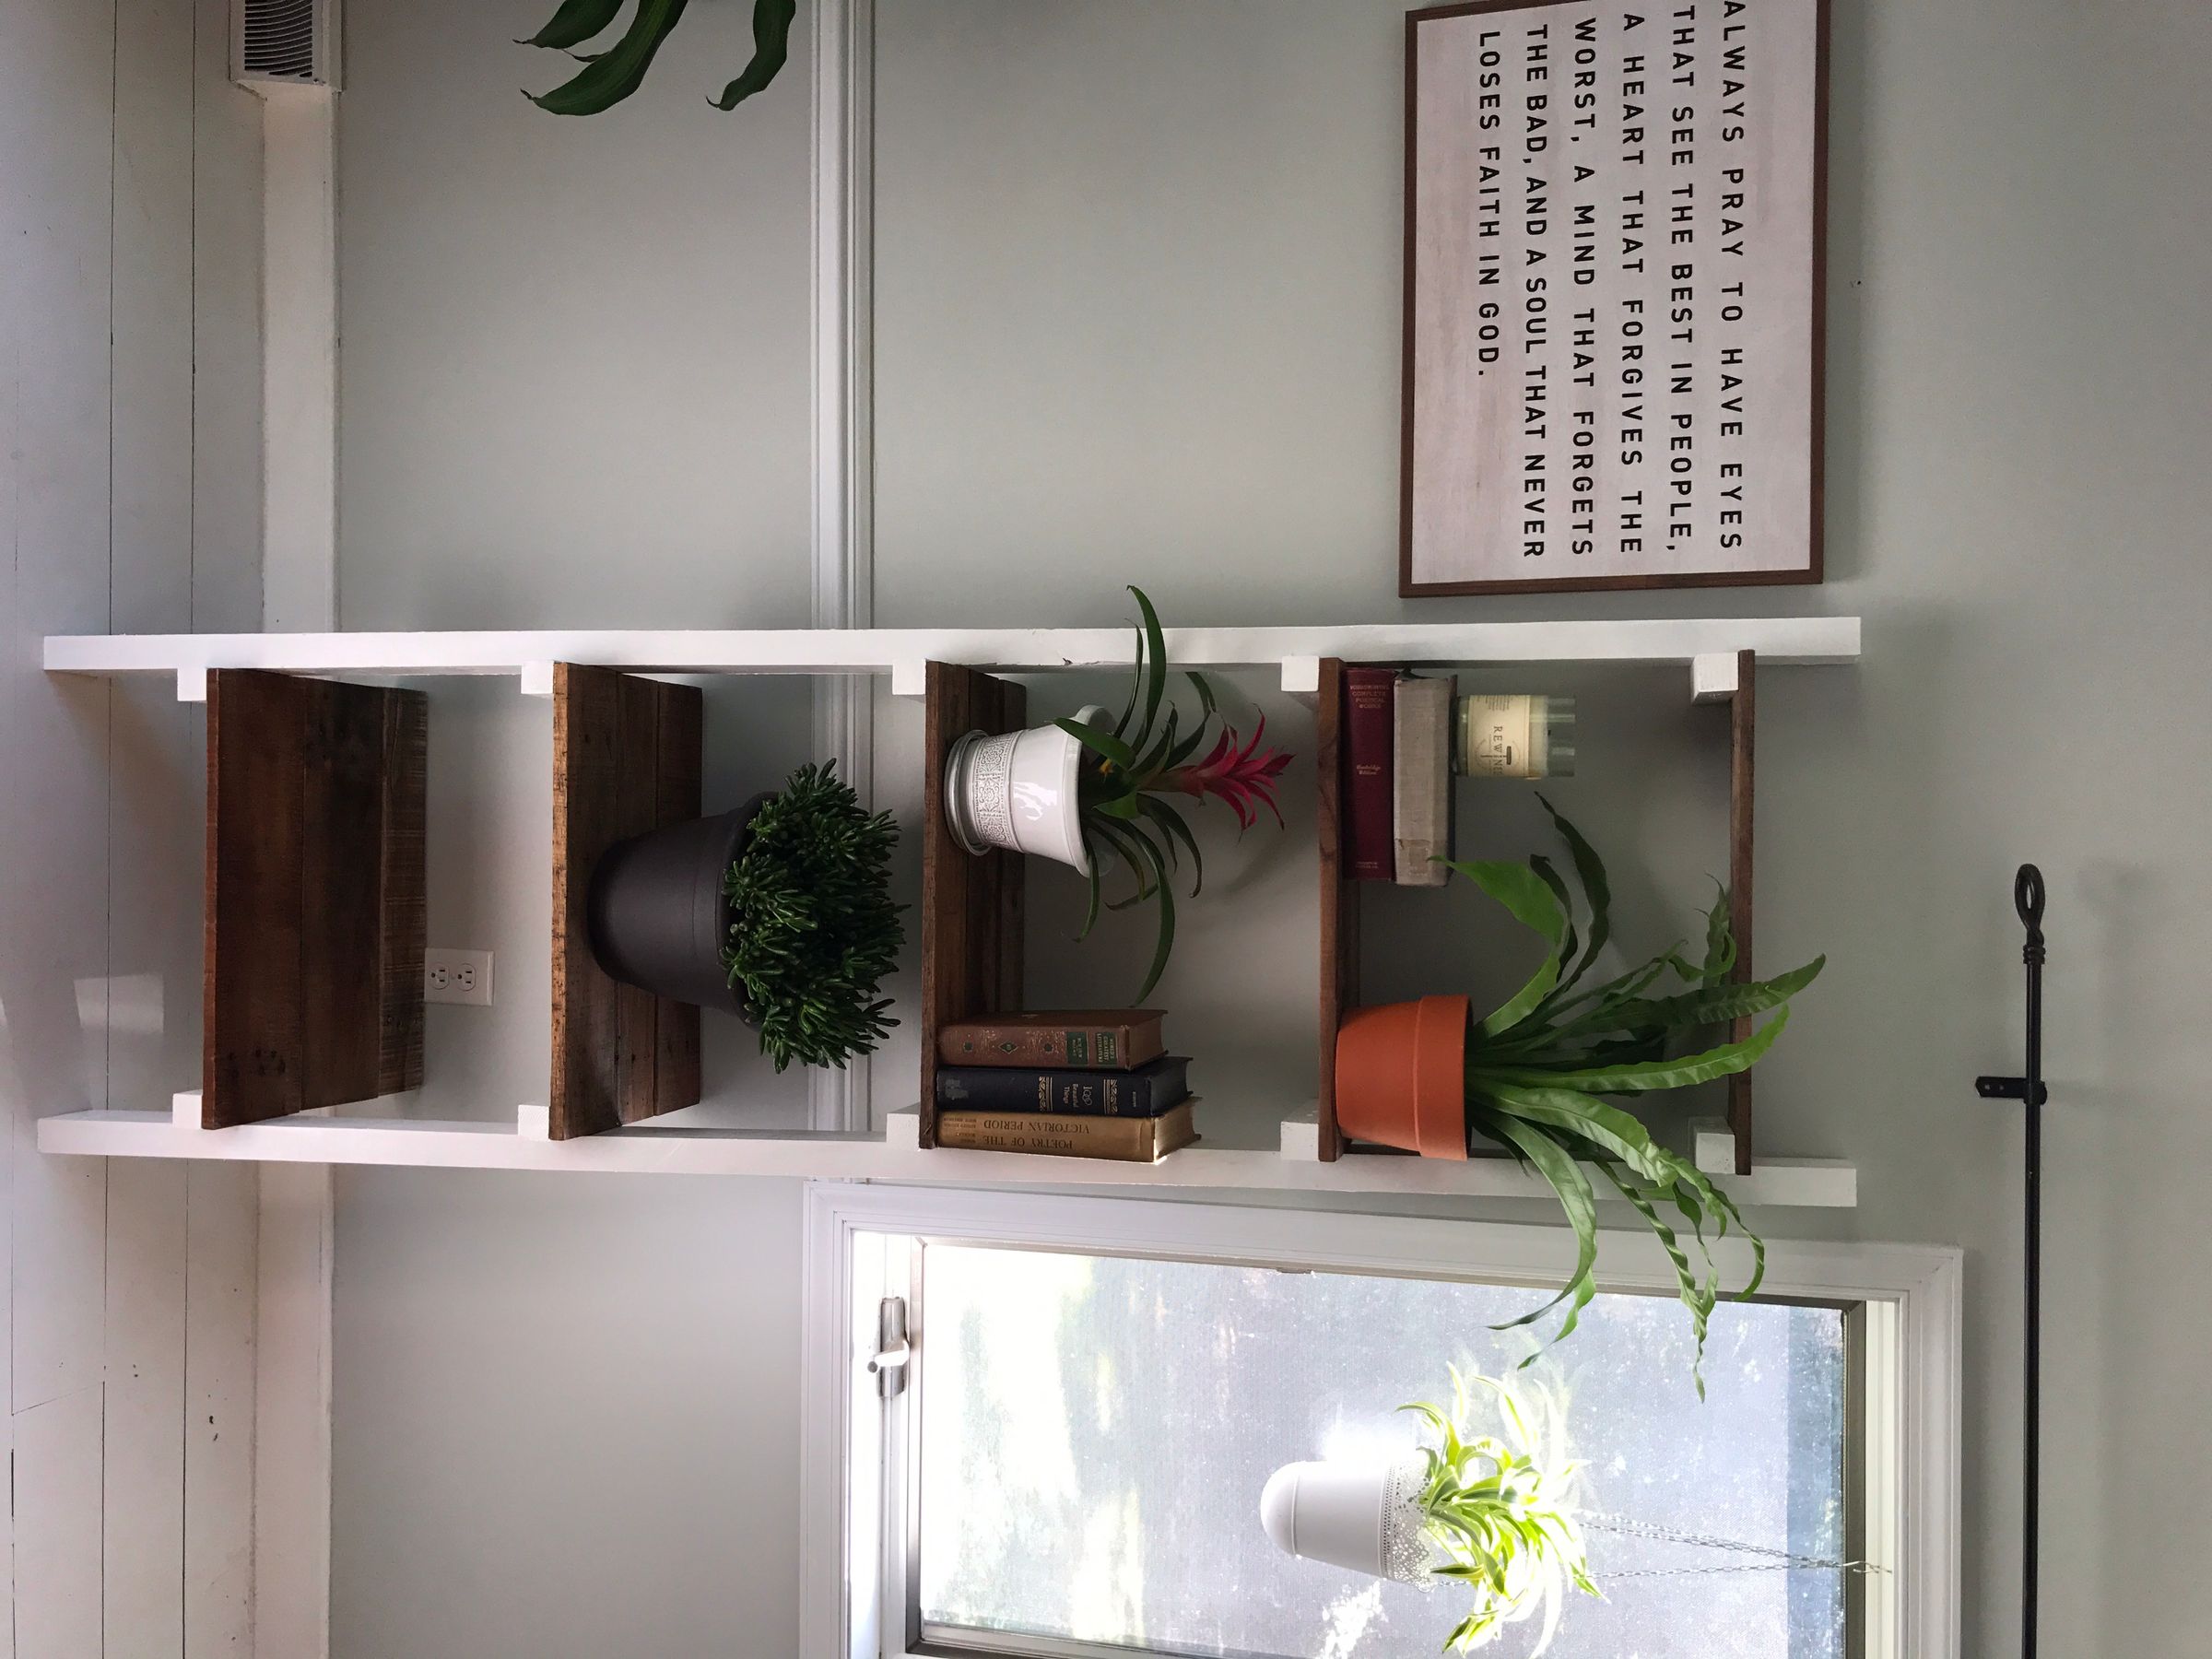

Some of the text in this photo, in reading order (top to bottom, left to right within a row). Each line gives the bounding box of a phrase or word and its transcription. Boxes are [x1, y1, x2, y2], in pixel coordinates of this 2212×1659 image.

[1478, 30, 1501, 376] LOSES FAITH IN GOD.
[1522, 23, 1548, 557] THE BAD, AND A SOUL THAT NEVER
[1570, 17, 1596, 555] WORST, A MIND THAT FORGETS
[1620, 13, 1645, 553] A HEART THAT FORGIVES THE
[1665, 5, 1696, 550] THAT SEE THE BEST IN PEOPLE,
[1720, 0, 1747, 548] ALWAYS PRAY TO HAVE EYES
[983, 1119, 1024, 1131] PERIOD
[983, 1135, 1006, 1146] THE
[1010, 1136, 1026, 1147] OF
[1029, 1122, 1090, 1135] VICTORIAN
[1031, 1137, 1073, 1149] POETRY
